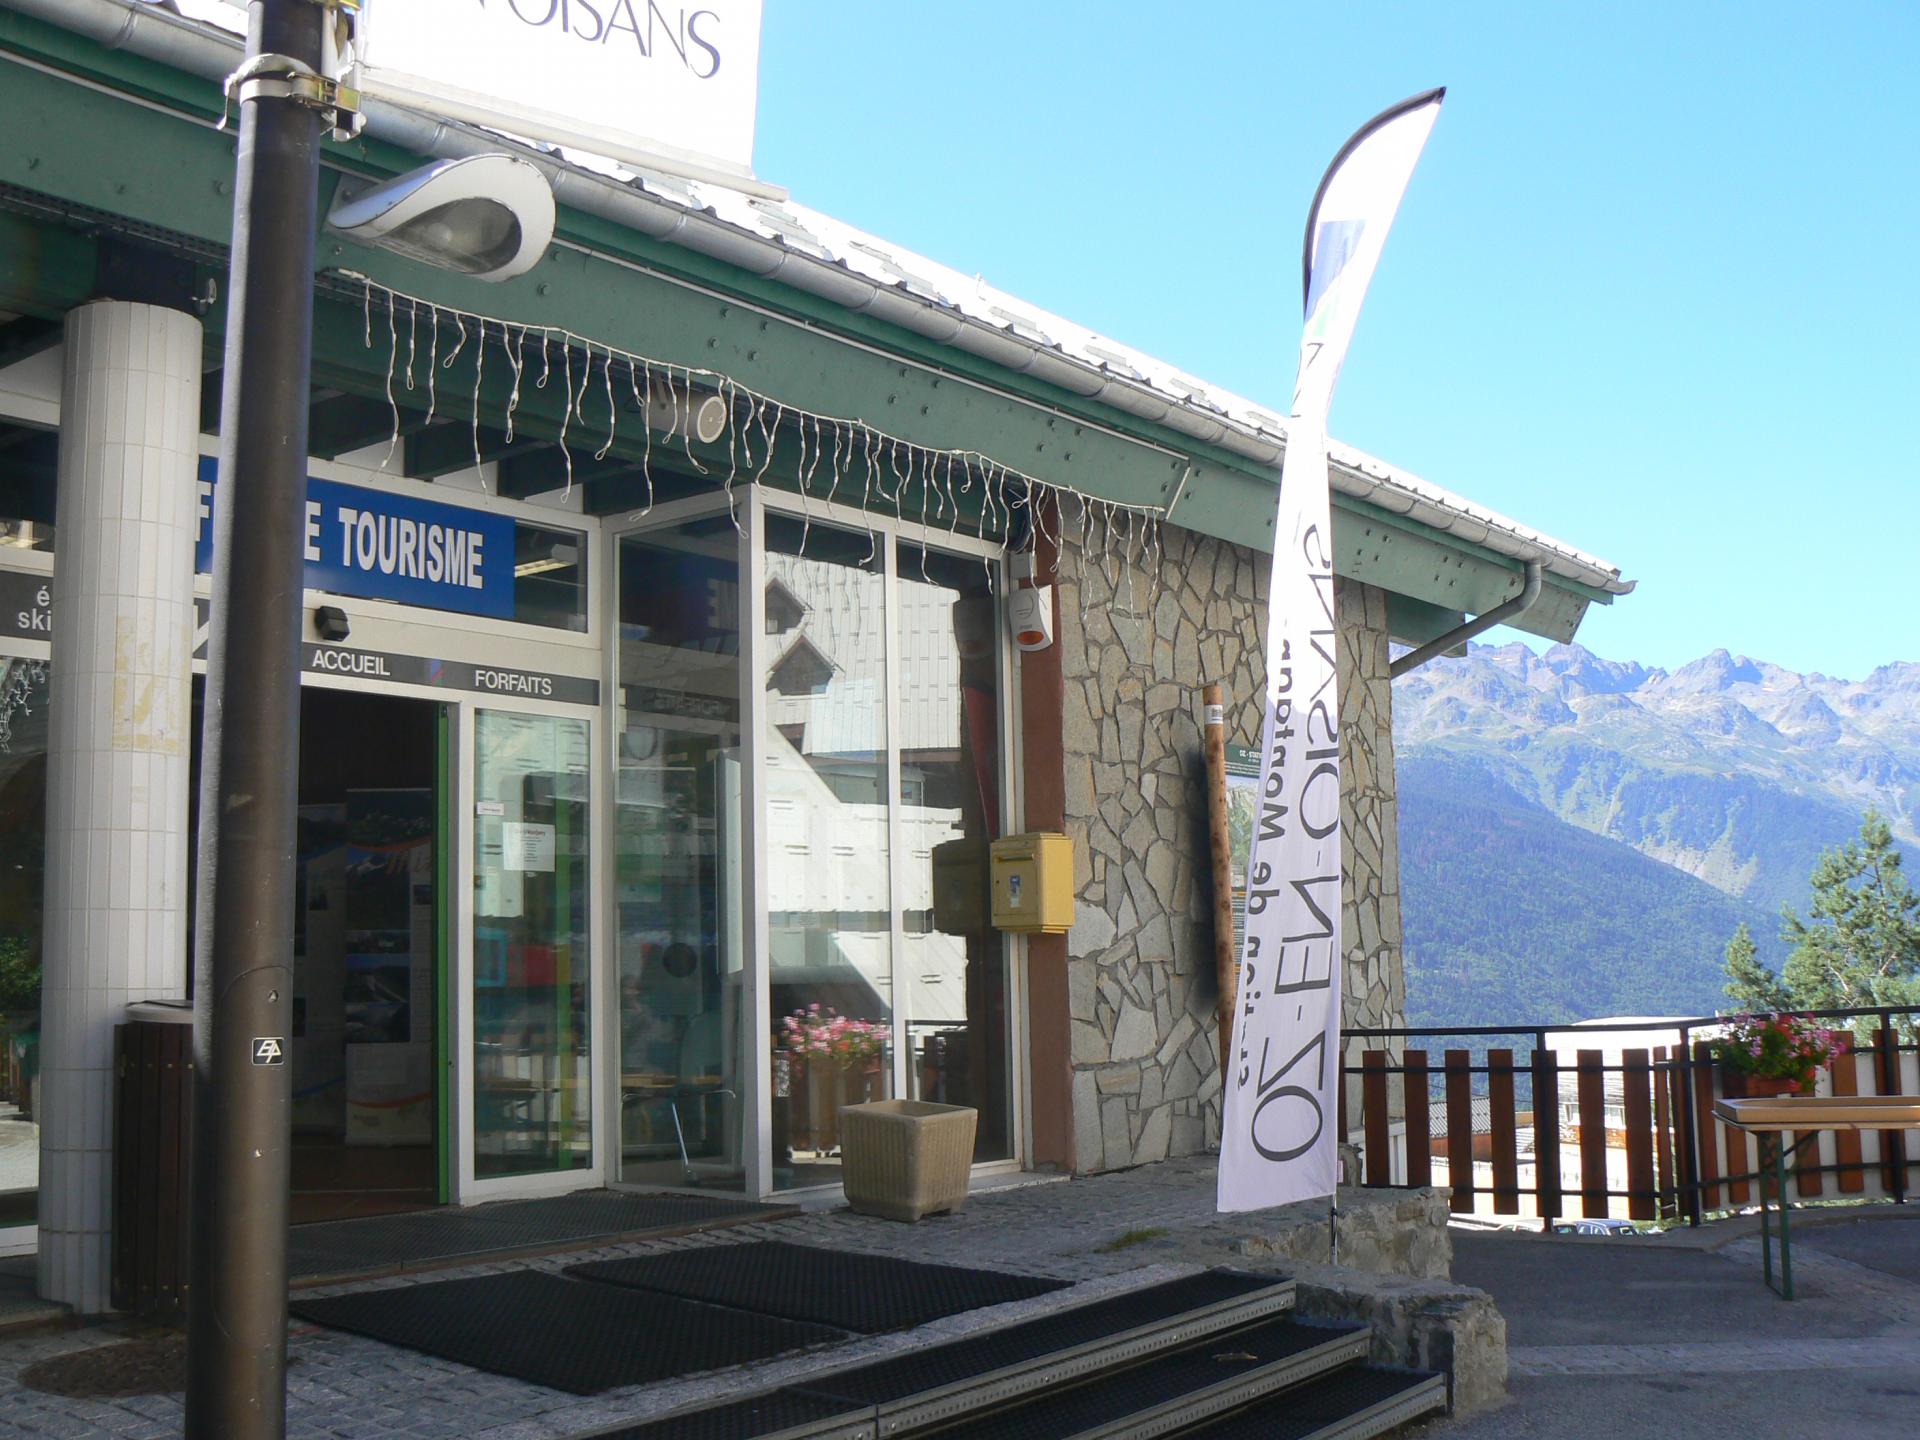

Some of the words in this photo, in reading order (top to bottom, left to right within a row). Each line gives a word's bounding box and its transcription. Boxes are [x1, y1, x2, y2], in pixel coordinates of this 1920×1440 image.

[339, 507, 484, 589] TOURISME
[312, 650, 391, 675] ACCUEIL
[475, 669, 552, 695] FORFAITS
